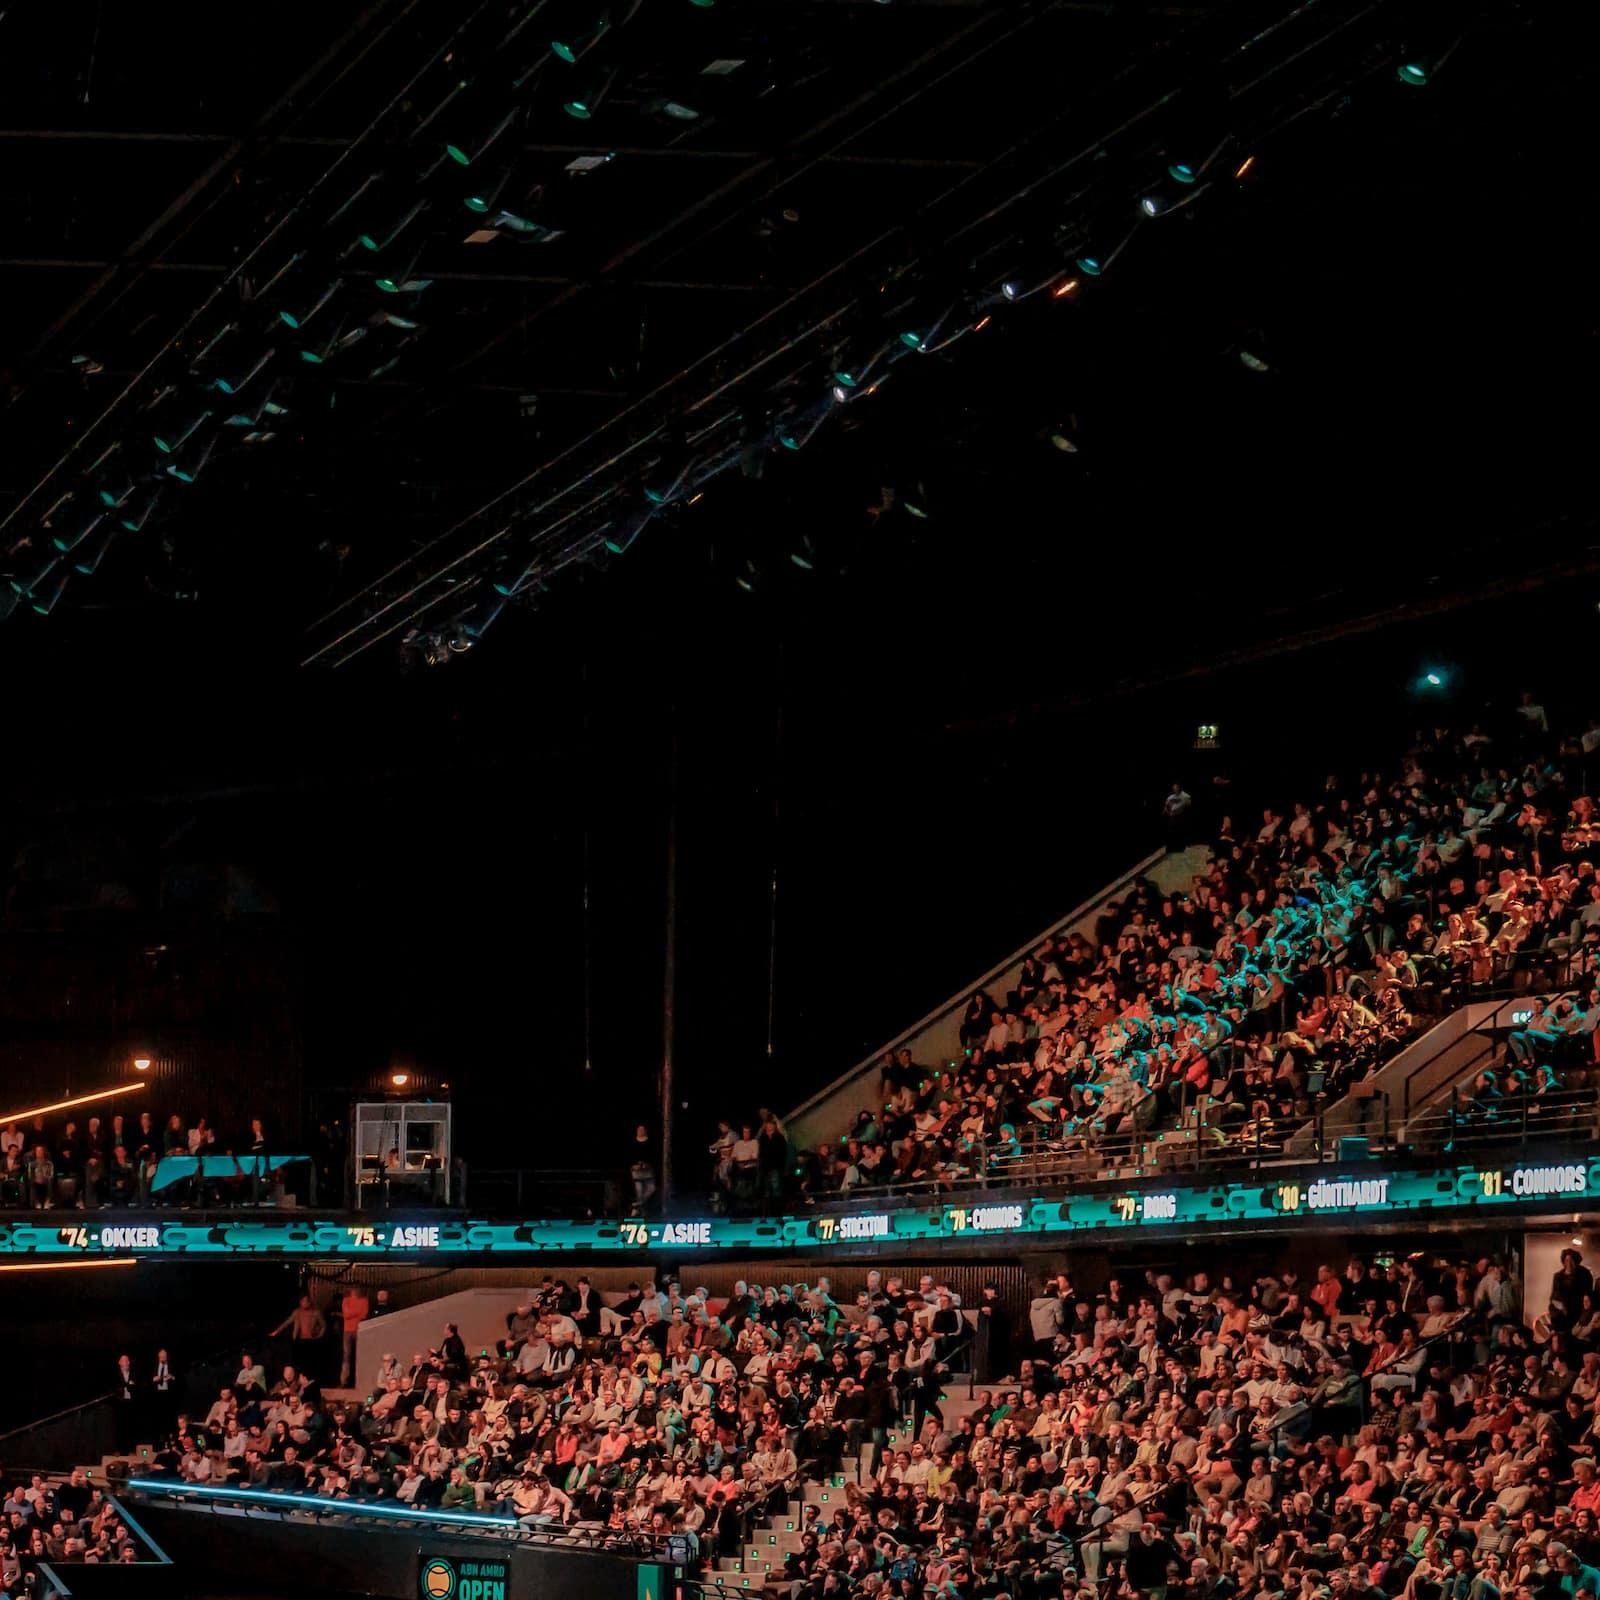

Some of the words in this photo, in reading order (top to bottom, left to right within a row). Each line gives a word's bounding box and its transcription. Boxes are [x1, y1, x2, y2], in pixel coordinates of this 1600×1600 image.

[1479, 1171, 1501, 1196] '81
[1513, 1165, 1586, 1195] CONNORS
[1308, 1179, 1388, 1209] GÜNTHARDT
[1143, 1194, 1176, 1219] BORG
[61, 1227, 88, 1248] '74
[101, 1227, 159, 1247] OKKER
[347, 1227, 375, 1247] '75
[391, 1227, 439, 1247] ASHE
[620, 1224, 648, 1244] '76
[662, 1223, 711, 1243] ASHE
[839, 1215, 888, 1239] STOCKTON
